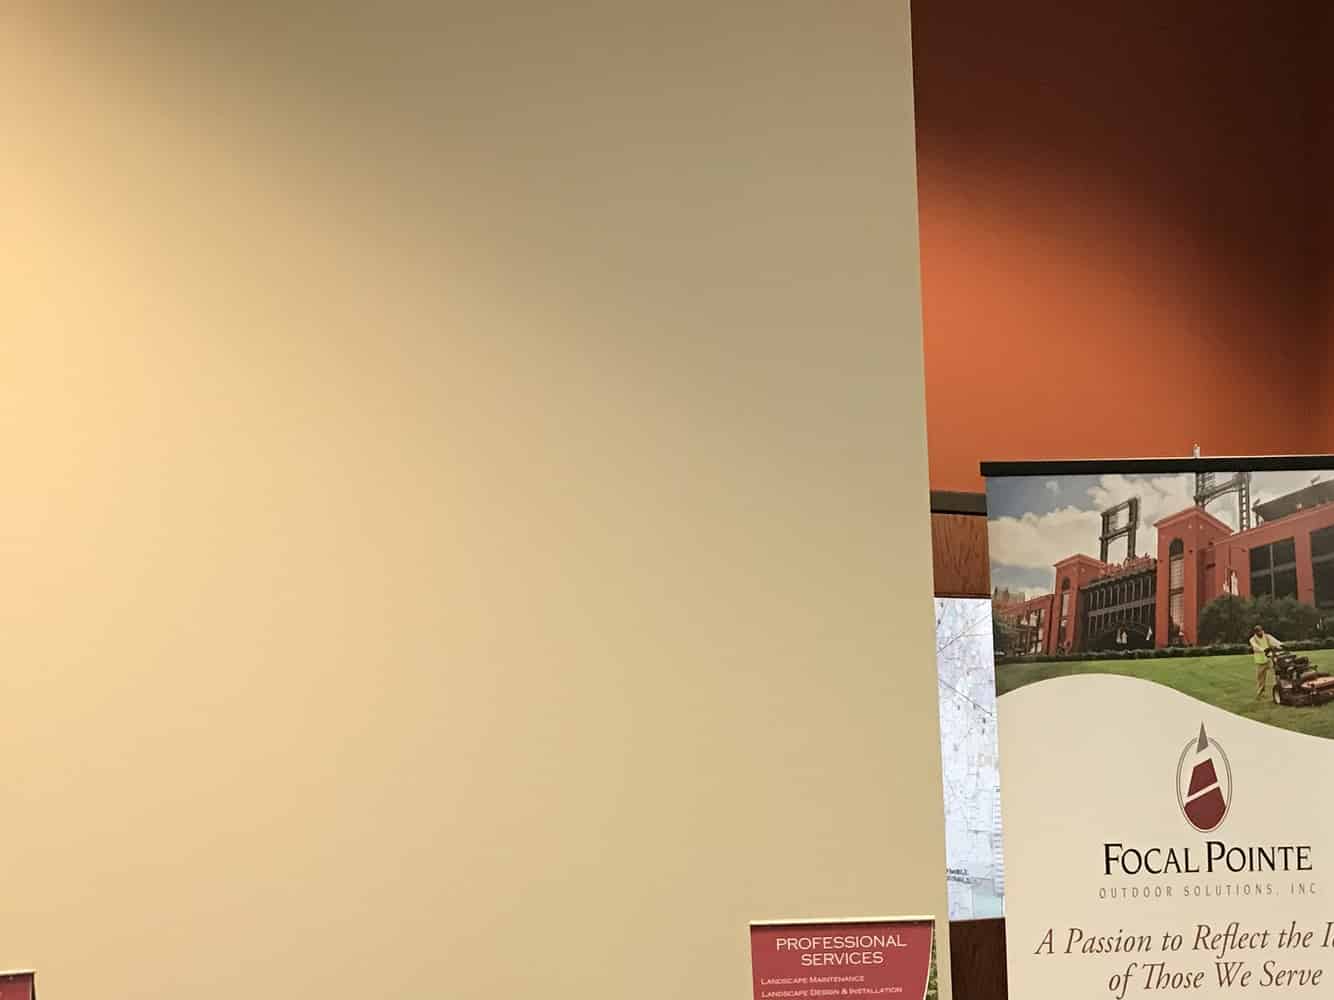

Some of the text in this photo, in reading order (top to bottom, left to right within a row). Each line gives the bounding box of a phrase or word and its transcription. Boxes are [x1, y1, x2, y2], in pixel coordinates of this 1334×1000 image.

[1103, 840, 1313, 876] FOCAL POINTE
[1099, 885, 1174, 899] OUTDOOR
[1183, 883, 1280, 898] SOLUTIONS,
[775, 934, 907, 951] PROFESSIONAL
[1035, 928, 1055, 955] A
[1063, 927, 1152, 955] Passion
[1161, 929, 1183, 952] to
[1192, 922, 1271, 960] Reflect
[1277, 920, 1312, 949] the
[800, 951, 884, 967] SERVICES
[760, 975, 864, 985] LANDSCAPE MAINTENANCE
[1108, 960, 1323, 999] of Those We Serve
[761, 990, 808, 998] LANDSCAPE
